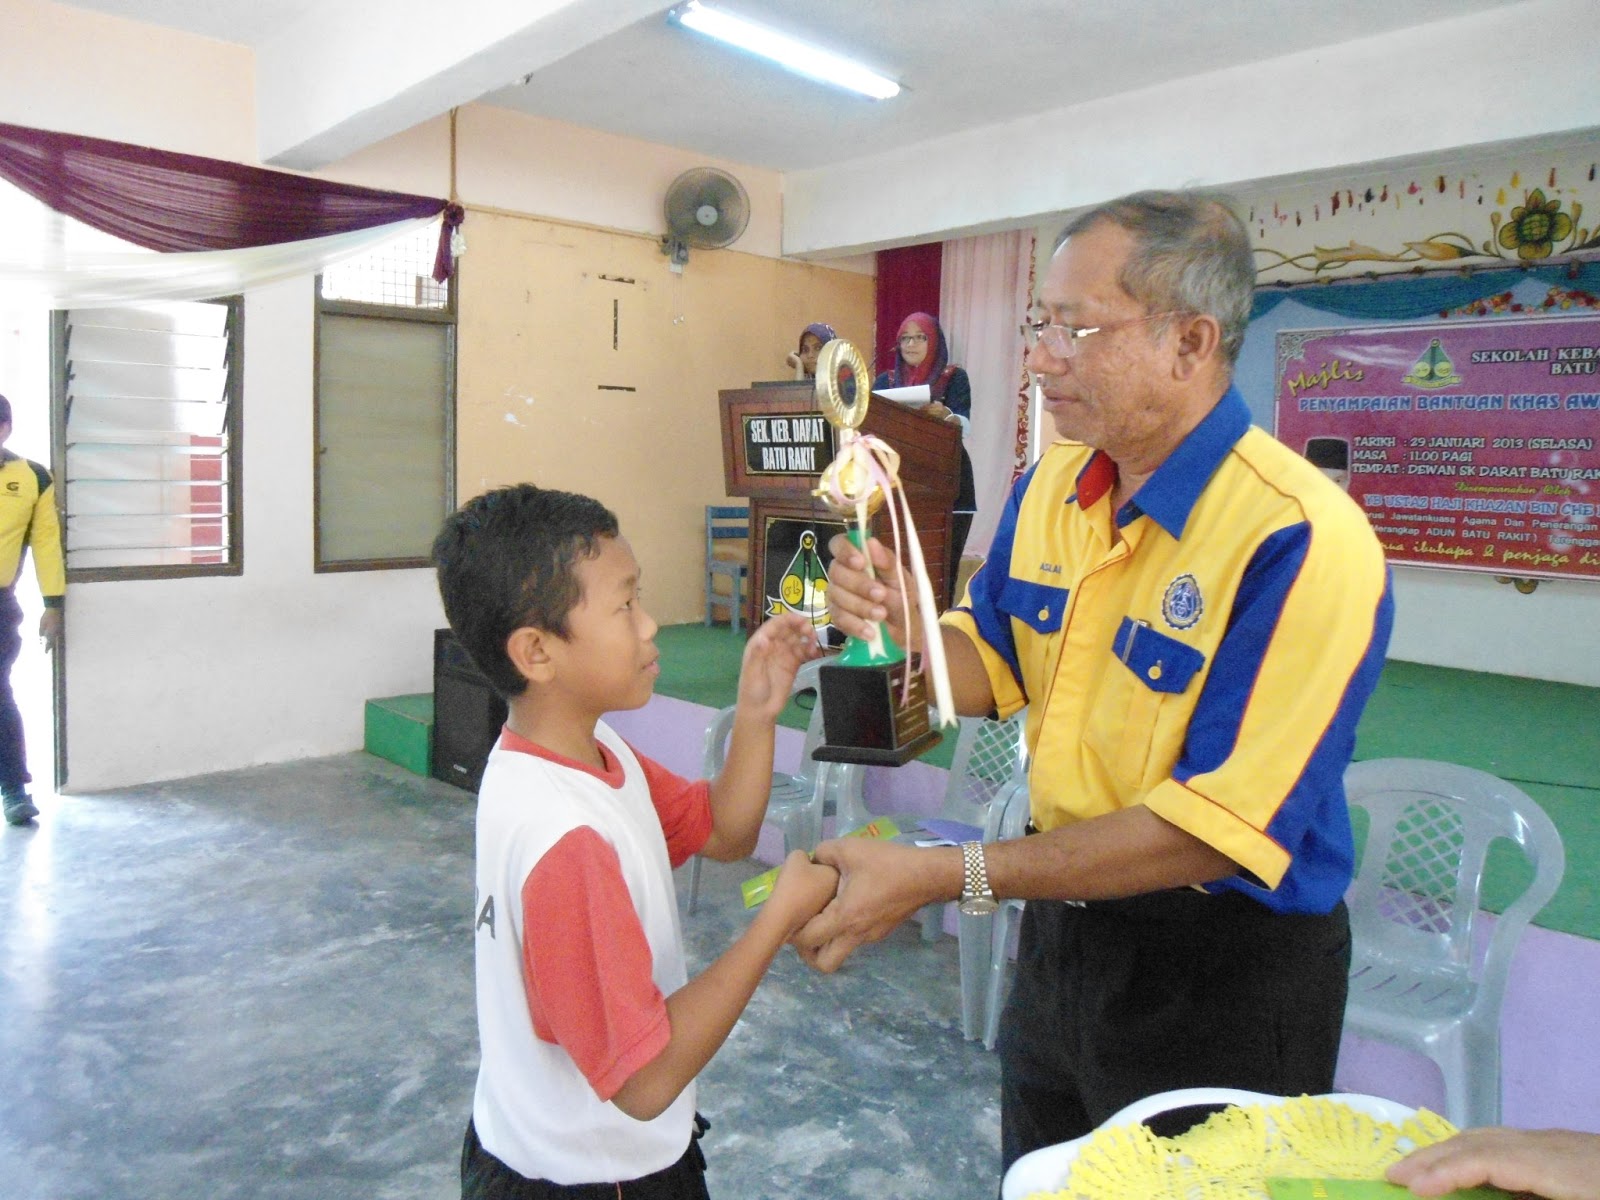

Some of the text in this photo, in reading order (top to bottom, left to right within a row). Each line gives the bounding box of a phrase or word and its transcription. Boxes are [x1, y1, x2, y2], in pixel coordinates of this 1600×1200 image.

[1471, 349, 1549, 362] SEKOLAH
[1550, 362, 1597, 375] BATU
[1287, 359, 1365, 397] Majlis
[1299, 396, 1412, 412] PENYAMPAIAN
[1416, 395, 1504, 411] BANTUAN
[1508, 394, 1560, 411] KHAS
[751, 419, 770, 442] SEK.
[771, 419, 791, 442] KEB.
[1353, 436, 1396, 447] TARIKH
[1410, 437, 1426, 447] 29
[1428, 437, 1485, 448] JANUARI
[1493, 438, 1524, 448] 2013
[1527, 438, 1593, 450] (SELASA)
[762, 447, 815, 471] BATU RAKIT
[1353, 450, 1387, 460] MASA
[1442, 451, 1473, 462] PAGI
[1352, 463, 1399, 474] TEMPAT
[1408, 464, 1456, 475] DEWAN
[1460, 465, 1476, 476] SK
[1479, 466, 1528, 478] DARAT
[1530, 467, 1569, 479] BATU
[1430, 496, 1463, 510] HAJI
[1464, 498, 1527, 513] KHAZAN
[1529, 501, 1558, 515] BIN
[1560, 502, 1595, 516] CHE
[1391, 512, 1456, 524] Jawatankuasa
[1462, 516, 1497, 526] Agama
[1504, 518, 1525, 528] Dan
[1532, 519, 1598, 532] Penerangan
[1426, 528, 1456, 537] ADUN
[1462, 529, 1491, 539] BATU
[1502, 548, 1570, 567] penjaga
